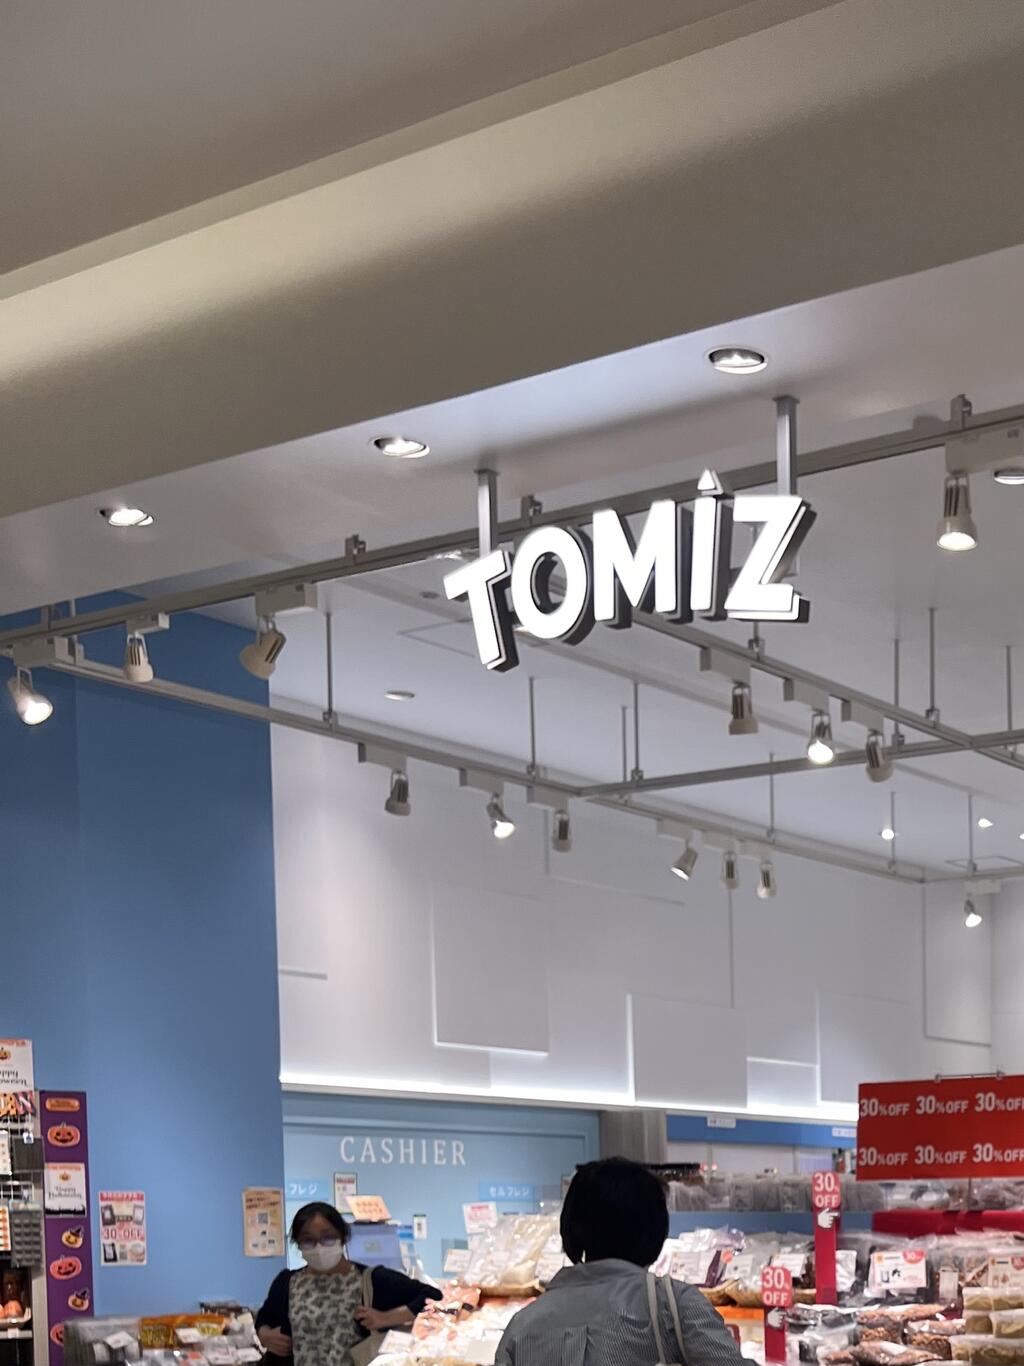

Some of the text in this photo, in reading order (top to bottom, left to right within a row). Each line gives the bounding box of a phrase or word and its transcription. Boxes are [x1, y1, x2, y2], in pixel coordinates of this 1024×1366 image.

[860, 1098, 910, 1117] 30%OFF
[915, 1095, 969, 1115] 30%OFF
[340, 1135, 467, 1166] CASHIER
[859, 1147, 909, 1166] 30%OFF
[914, 1145, 968, 1164] 30%OFF
[489, 1186, 529, 1198] セルフレジ
[815, 1194, 840, 1208] OFF
[763, 1291, 788, 1306] OFF
